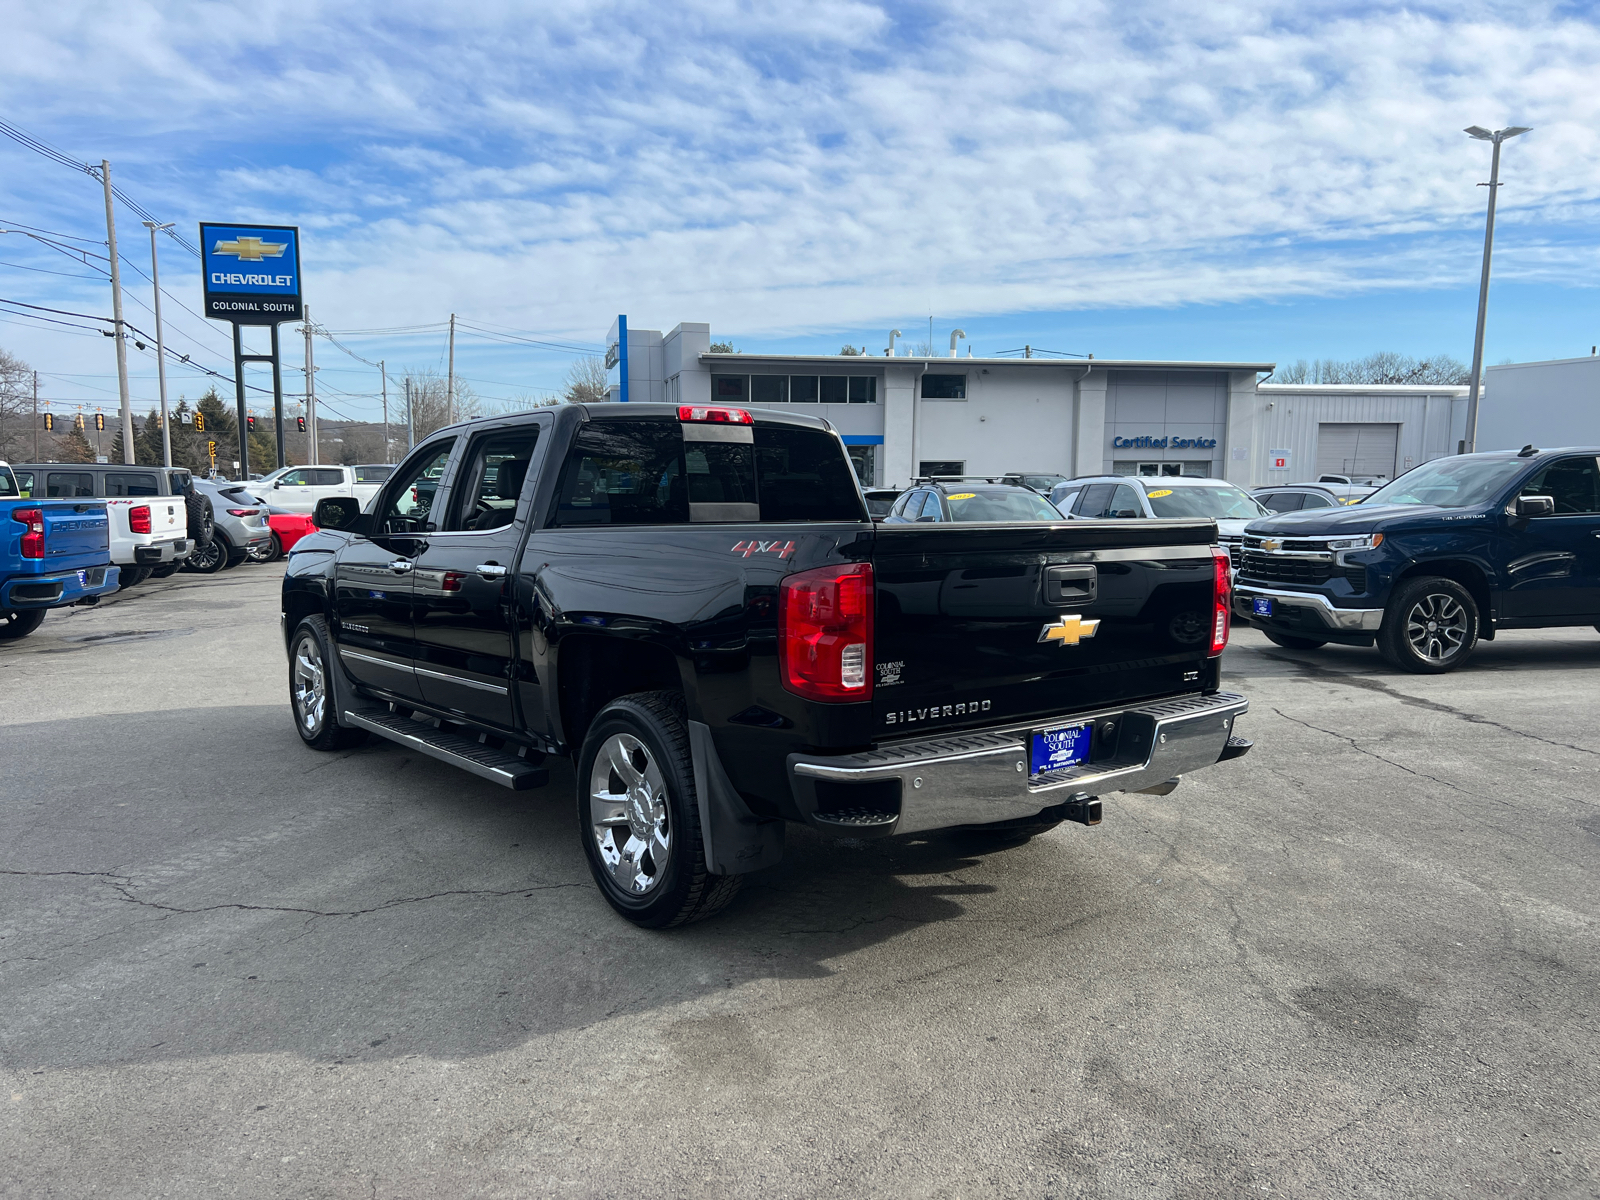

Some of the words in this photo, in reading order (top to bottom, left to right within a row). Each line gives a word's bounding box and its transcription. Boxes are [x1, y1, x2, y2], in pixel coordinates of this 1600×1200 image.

[211, 272, 293, 287] CHEVROLET
[212, 301, 260, 311] COLONIAL
[263, 303, 295, 312] SOUTH
[1114, 435, 1168, 449] Certified
[1172, 436, 1217, 449] Service
[875, 660, 905, 671] COLONIAL
[880, 667, 900, 676] SOUTH
[1183, 670, 1199, 681] LTZ
[885, 699, 991, 724] SILVERADO
[1043, 729, 1081, 744] COLONIAL
[1048, 739, 1075, 752] SOUTH
